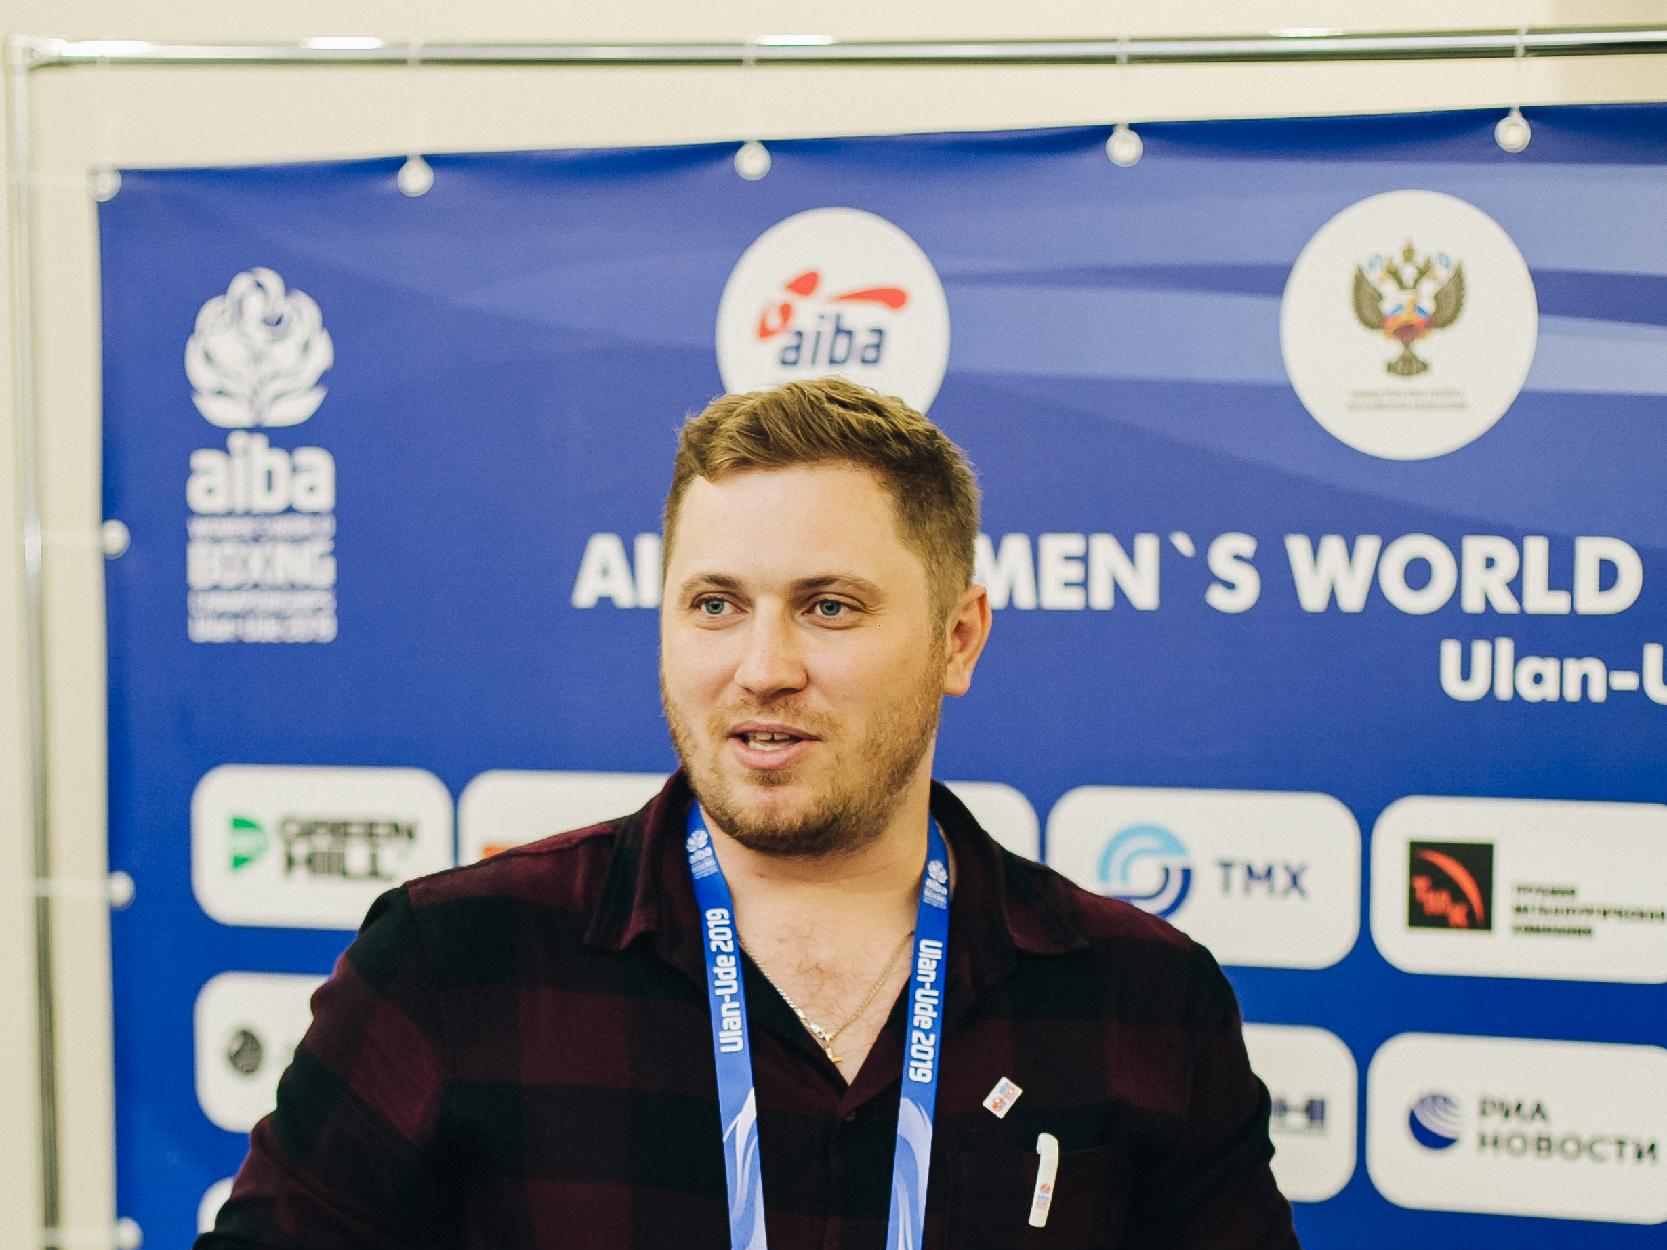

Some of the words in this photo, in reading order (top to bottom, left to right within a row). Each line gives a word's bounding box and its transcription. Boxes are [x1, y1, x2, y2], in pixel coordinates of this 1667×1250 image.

[778, 313, 886, 367] aiba
[187, 431, 336, 515] aiba
[569, 532, 664, 609] AI
[973, 530, 1262, 614] MEN`S
[1286, 532, 1644, 616] WORLD
[706, 907, 735, 953] 2019
[713, 954, 744, 1053] Ulan-Ude
[911, 939, 943, 1030] Ulan-Ude
[908, 1031, 937, 1084] 2019
[1478, 1096, 1549, 1123] РИА
[1478, 1132, 1659, 1165] НОВОСТИ
